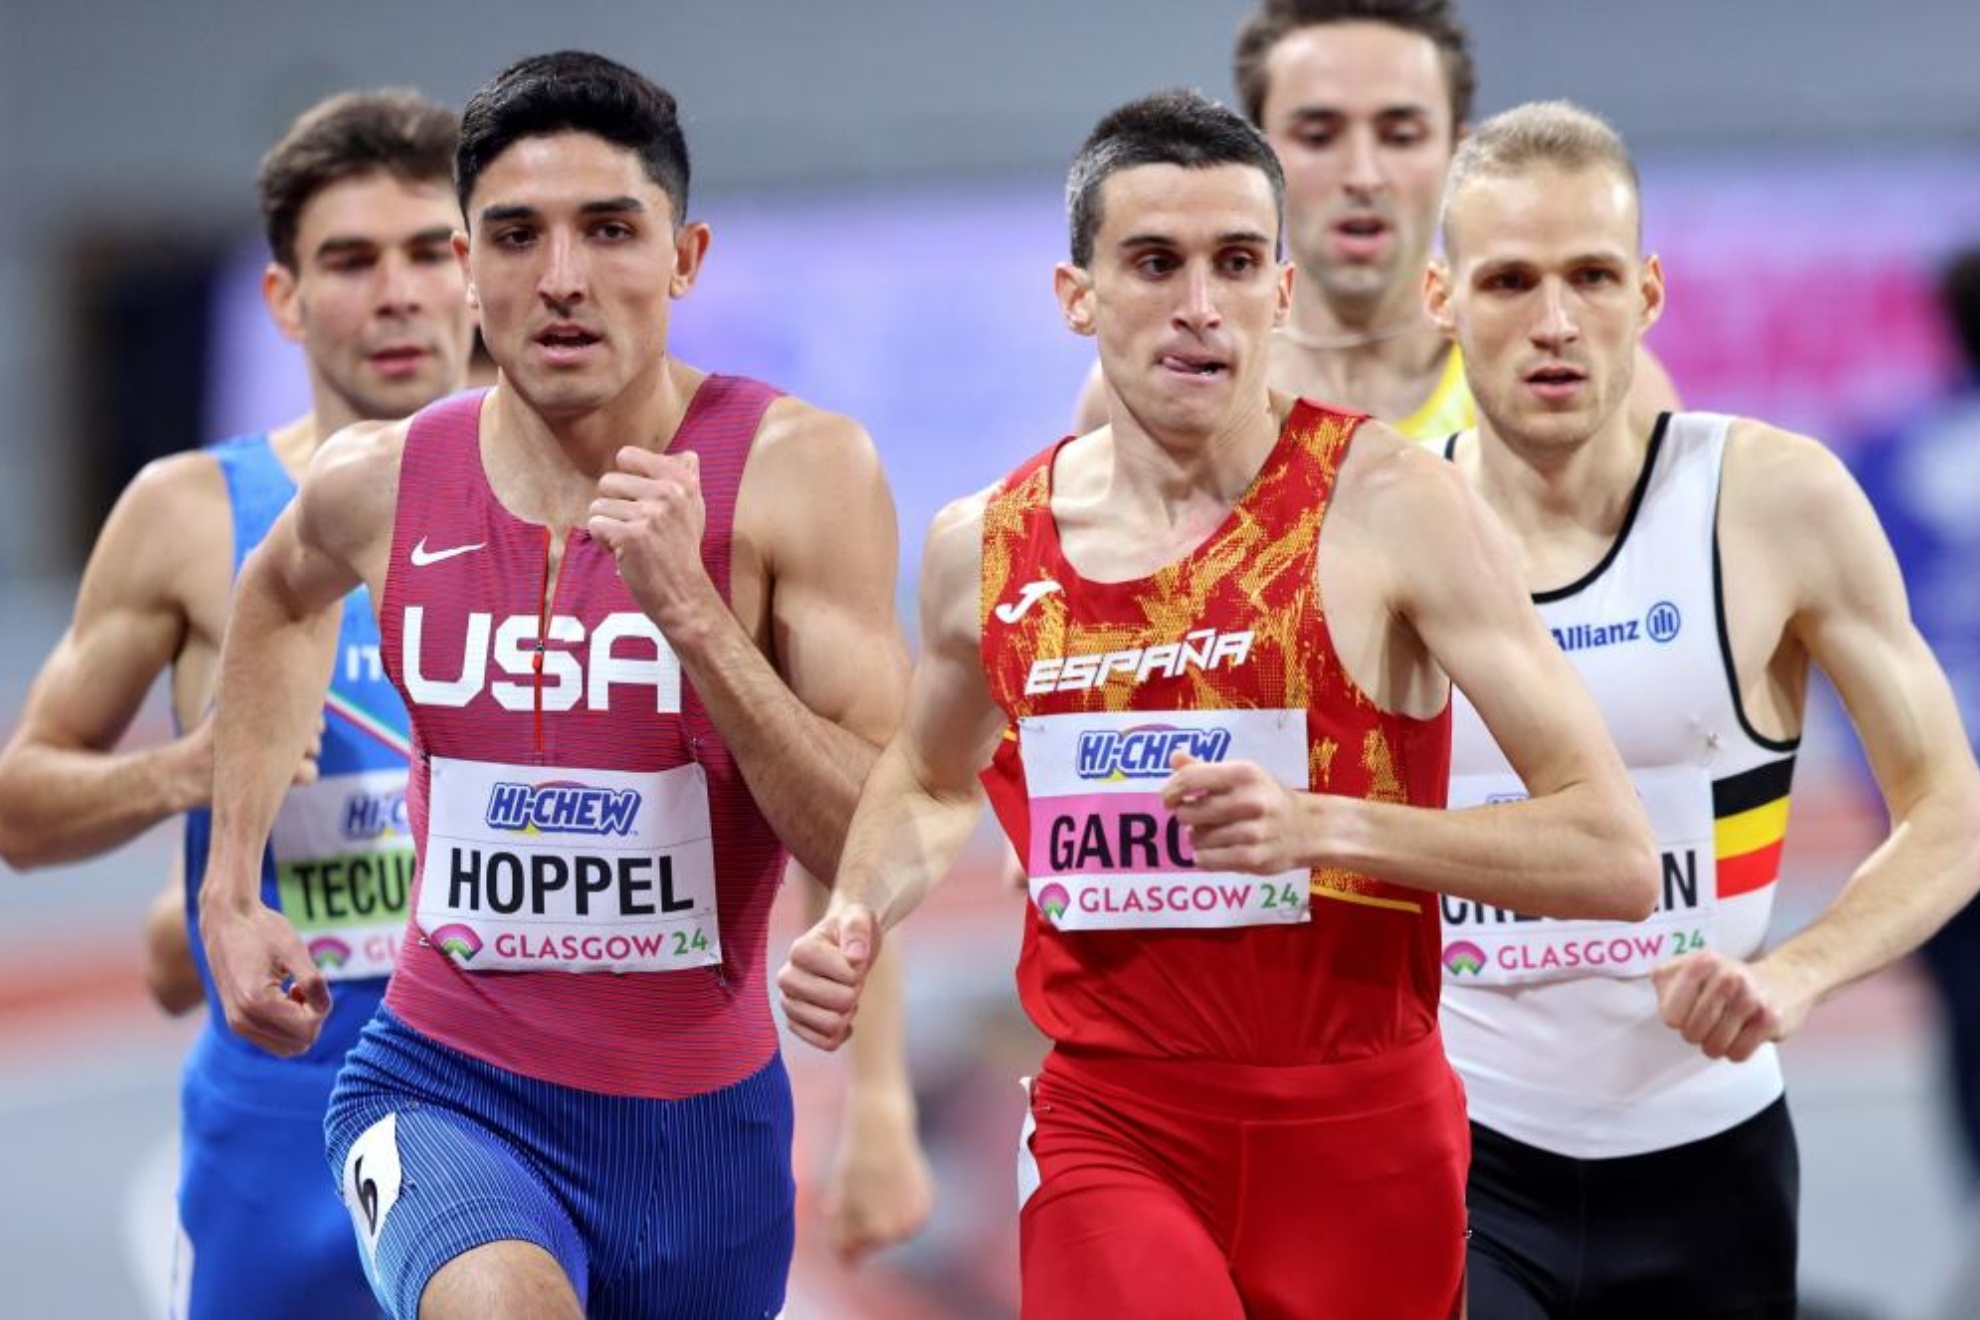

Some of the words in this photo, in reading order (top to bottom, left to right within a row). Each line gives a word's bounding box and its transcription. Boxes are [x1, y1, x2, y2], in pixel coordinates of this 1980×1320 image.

[402, 606, 681, 714] USA
[1024, 628, 1256, 696] ESPAÑA
[487, 784, 642, 836] HI-CHEW
[447, 847, 695, 916] HOPPEL
[1079, 884, 1252, 913] GLASGOW
[1259, 883, 1299, 909] 24
[495, 933, 664, 961] GLASGOW
[672, 927, 708, 956] 24
[1497, 934, 1665, 971] GLASGOW
[1671, 929, 1707, 956] 24
